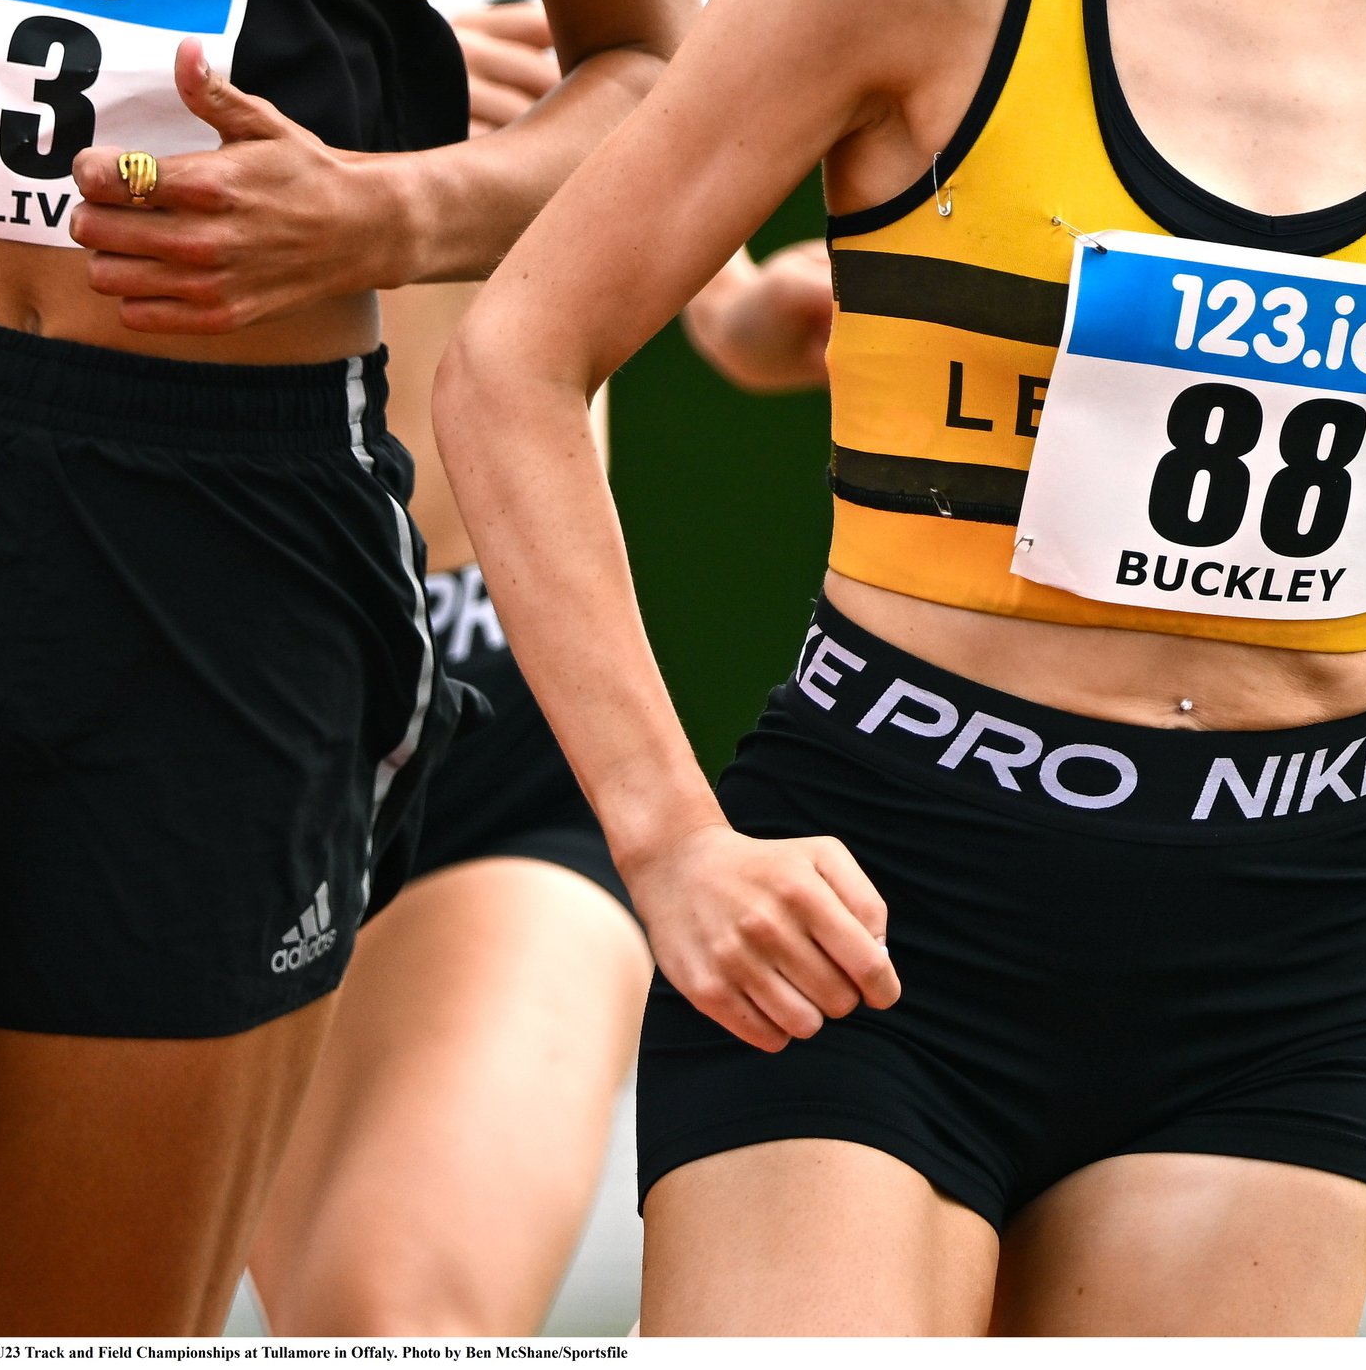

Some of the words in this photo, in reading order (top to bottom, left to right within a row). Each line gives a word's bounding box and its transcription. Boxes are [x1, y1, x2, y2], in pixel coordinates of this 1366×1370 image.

[1114, 549, 1348, 603] BUCKLEY
[855, 677, 1139, 810] PRO
[270, 928, 338, 974] adidas
